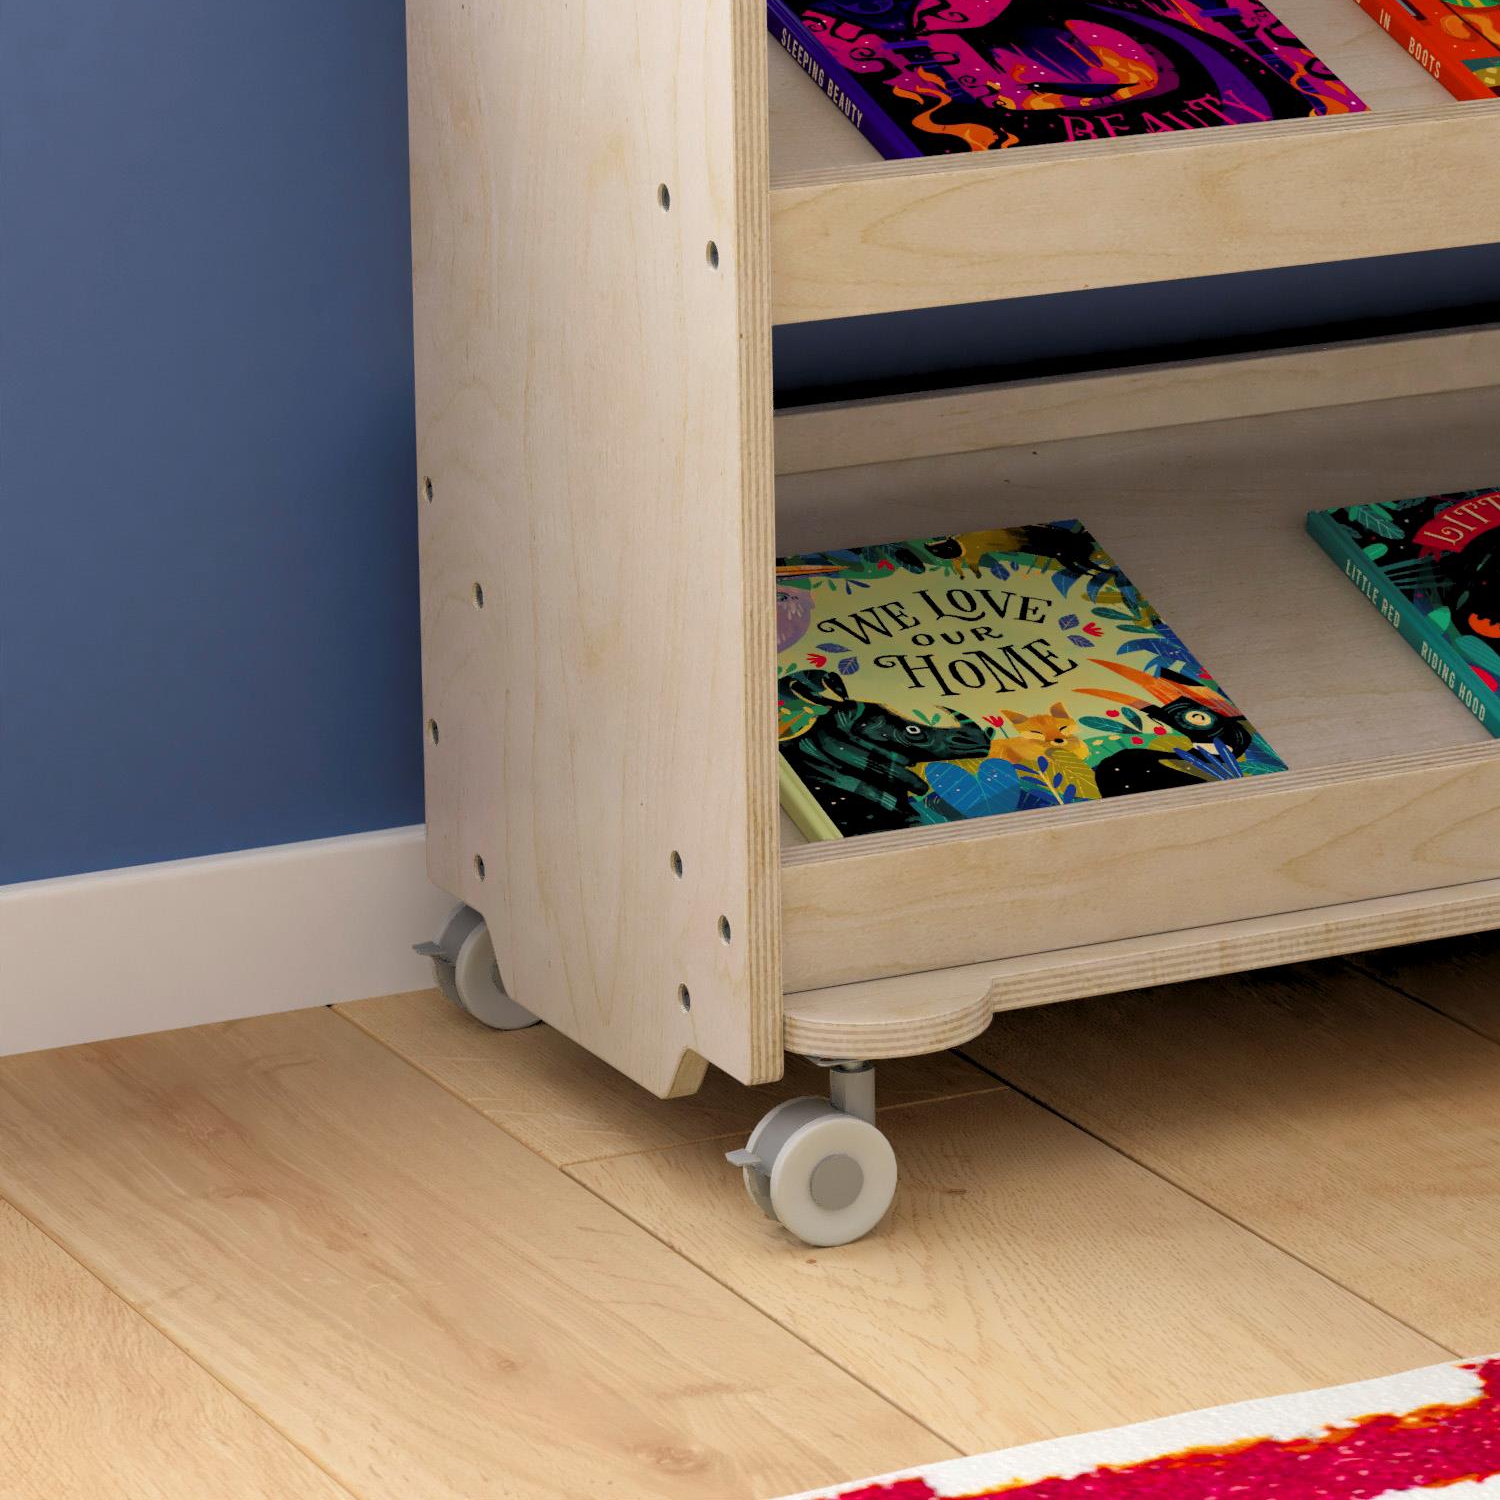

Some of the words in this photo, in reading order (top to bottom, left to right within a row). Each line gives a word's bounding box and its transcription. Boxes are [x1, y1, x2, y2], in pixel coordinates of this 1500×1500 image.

[1379, 8, 1391, 31] IN
[1408, 36, 1441, 79] BOOTS
[780, 27, 825, 88] SLEEPING
[826, 78, 863, 128] BEAUTY
[817, 601, 921, 645] WE
[912, 589, 1053, 624] LOVE
[911, 626, 1004, 647] OUR
[1345, 559, 1380, 605] LITTLE
[1381, 597, 1400, 629] RED
[1420, 641, 1455, 689] RIDING
[1458, 681, 1486, 722] HOOD
[873, 638, 1079, 697] HOME
